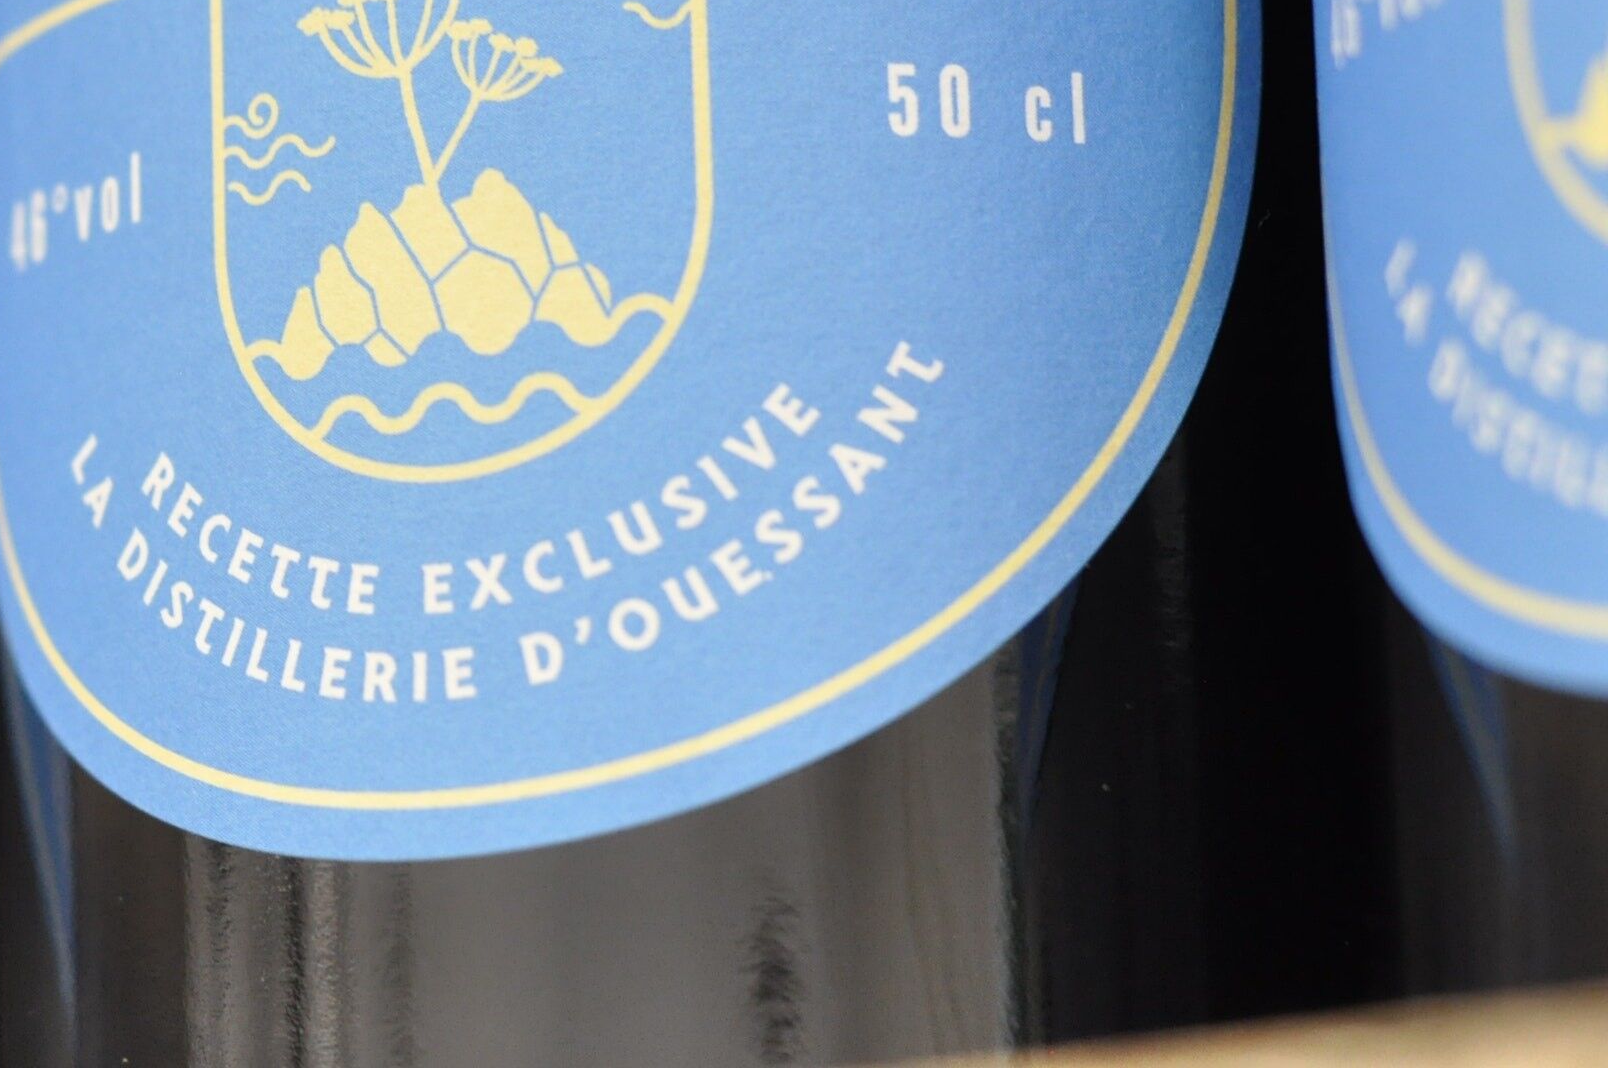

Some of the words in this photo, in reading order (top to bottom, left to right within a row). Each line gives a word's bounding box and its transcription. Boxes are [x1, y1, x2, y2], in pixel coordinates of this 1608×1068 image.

[887, 63, 971, 138] 50
[1025, 72, 1086, 144] cl
[69, 434, 114, 528] LA
[116, 528, 478, 702] DISTILLERIE
[519, 340, 945, 685] D'OUESSANT
[141, 451, 379, 615] RECETTE
[423, 383, 822, 615] EXCLUSIVE
